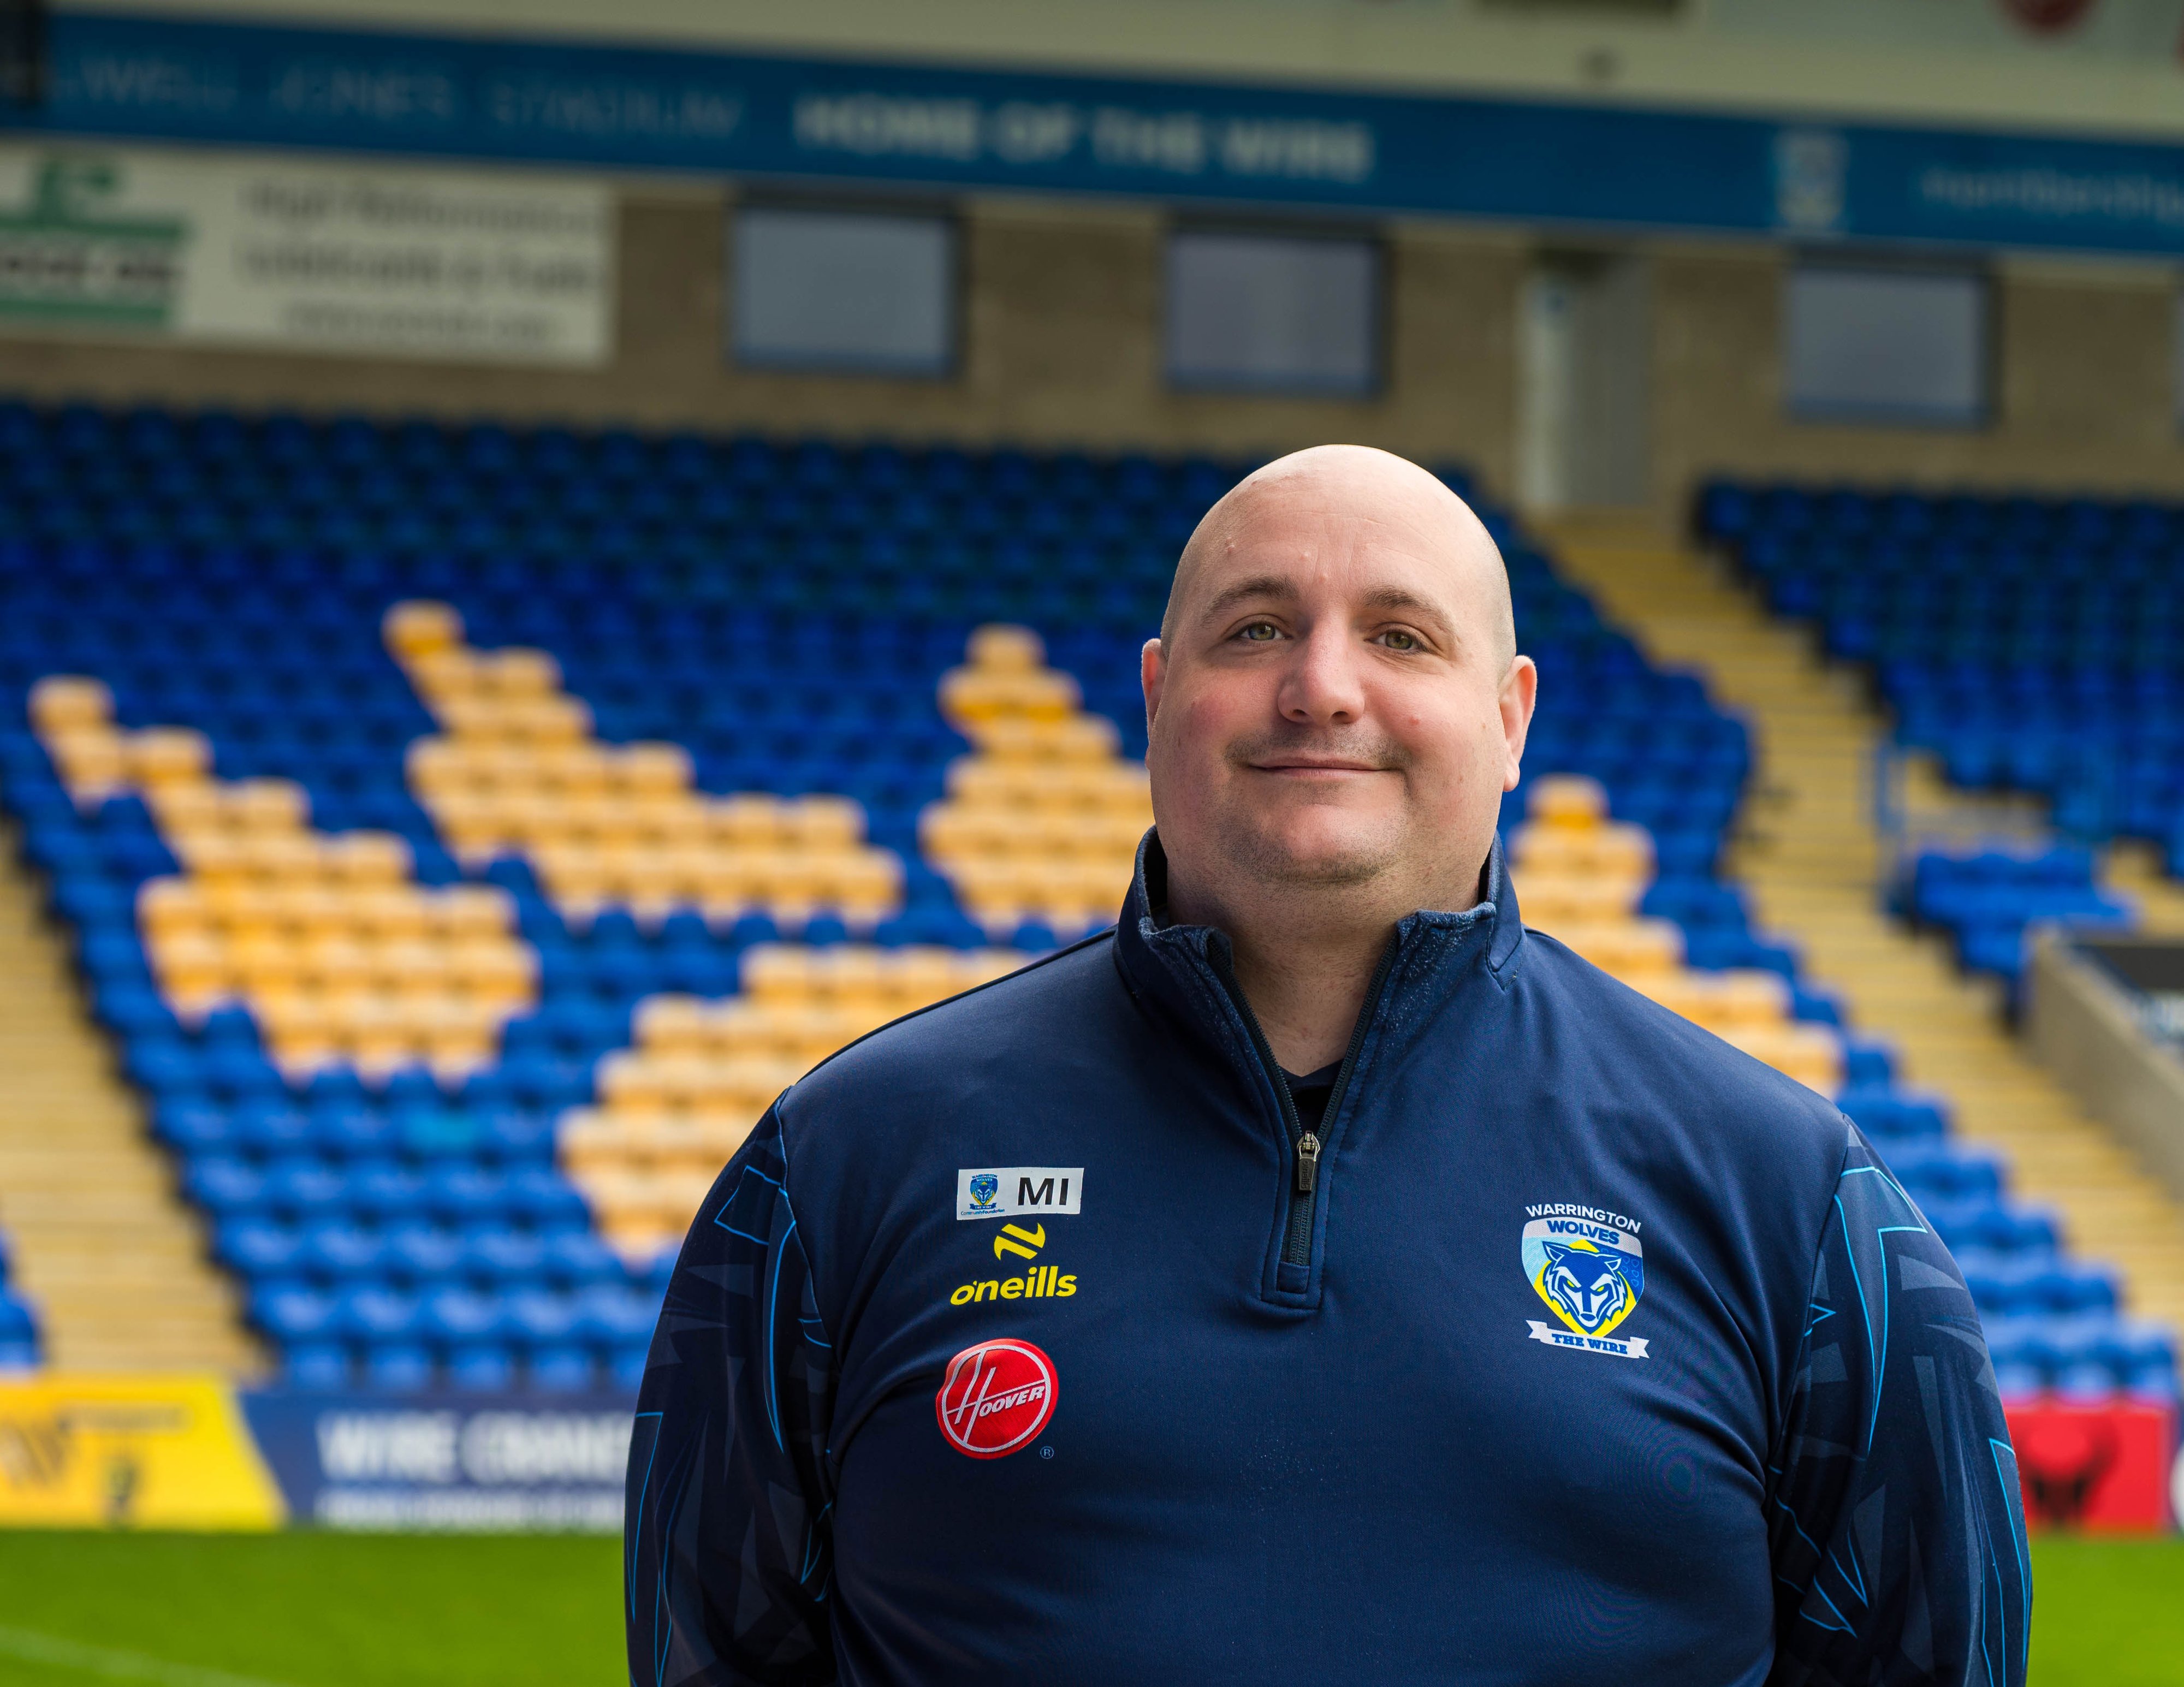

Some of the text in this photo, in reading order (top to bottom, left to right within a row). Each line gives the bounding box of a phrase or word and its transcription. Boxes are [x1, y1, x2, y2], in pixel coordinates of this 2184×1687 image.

[792, 93, 1376, 185] HOME OF THE WIRE
[1017, 1177, 1069, 1206] MI
[1525, 1203, 1642, 1234] WARRINGTON
[1546, 1220, 1620, 1245] WOLVES
[950, 1266, 1077, 1305] o'neills
[1551, 1333, 1628, 1355] THE WIRE
